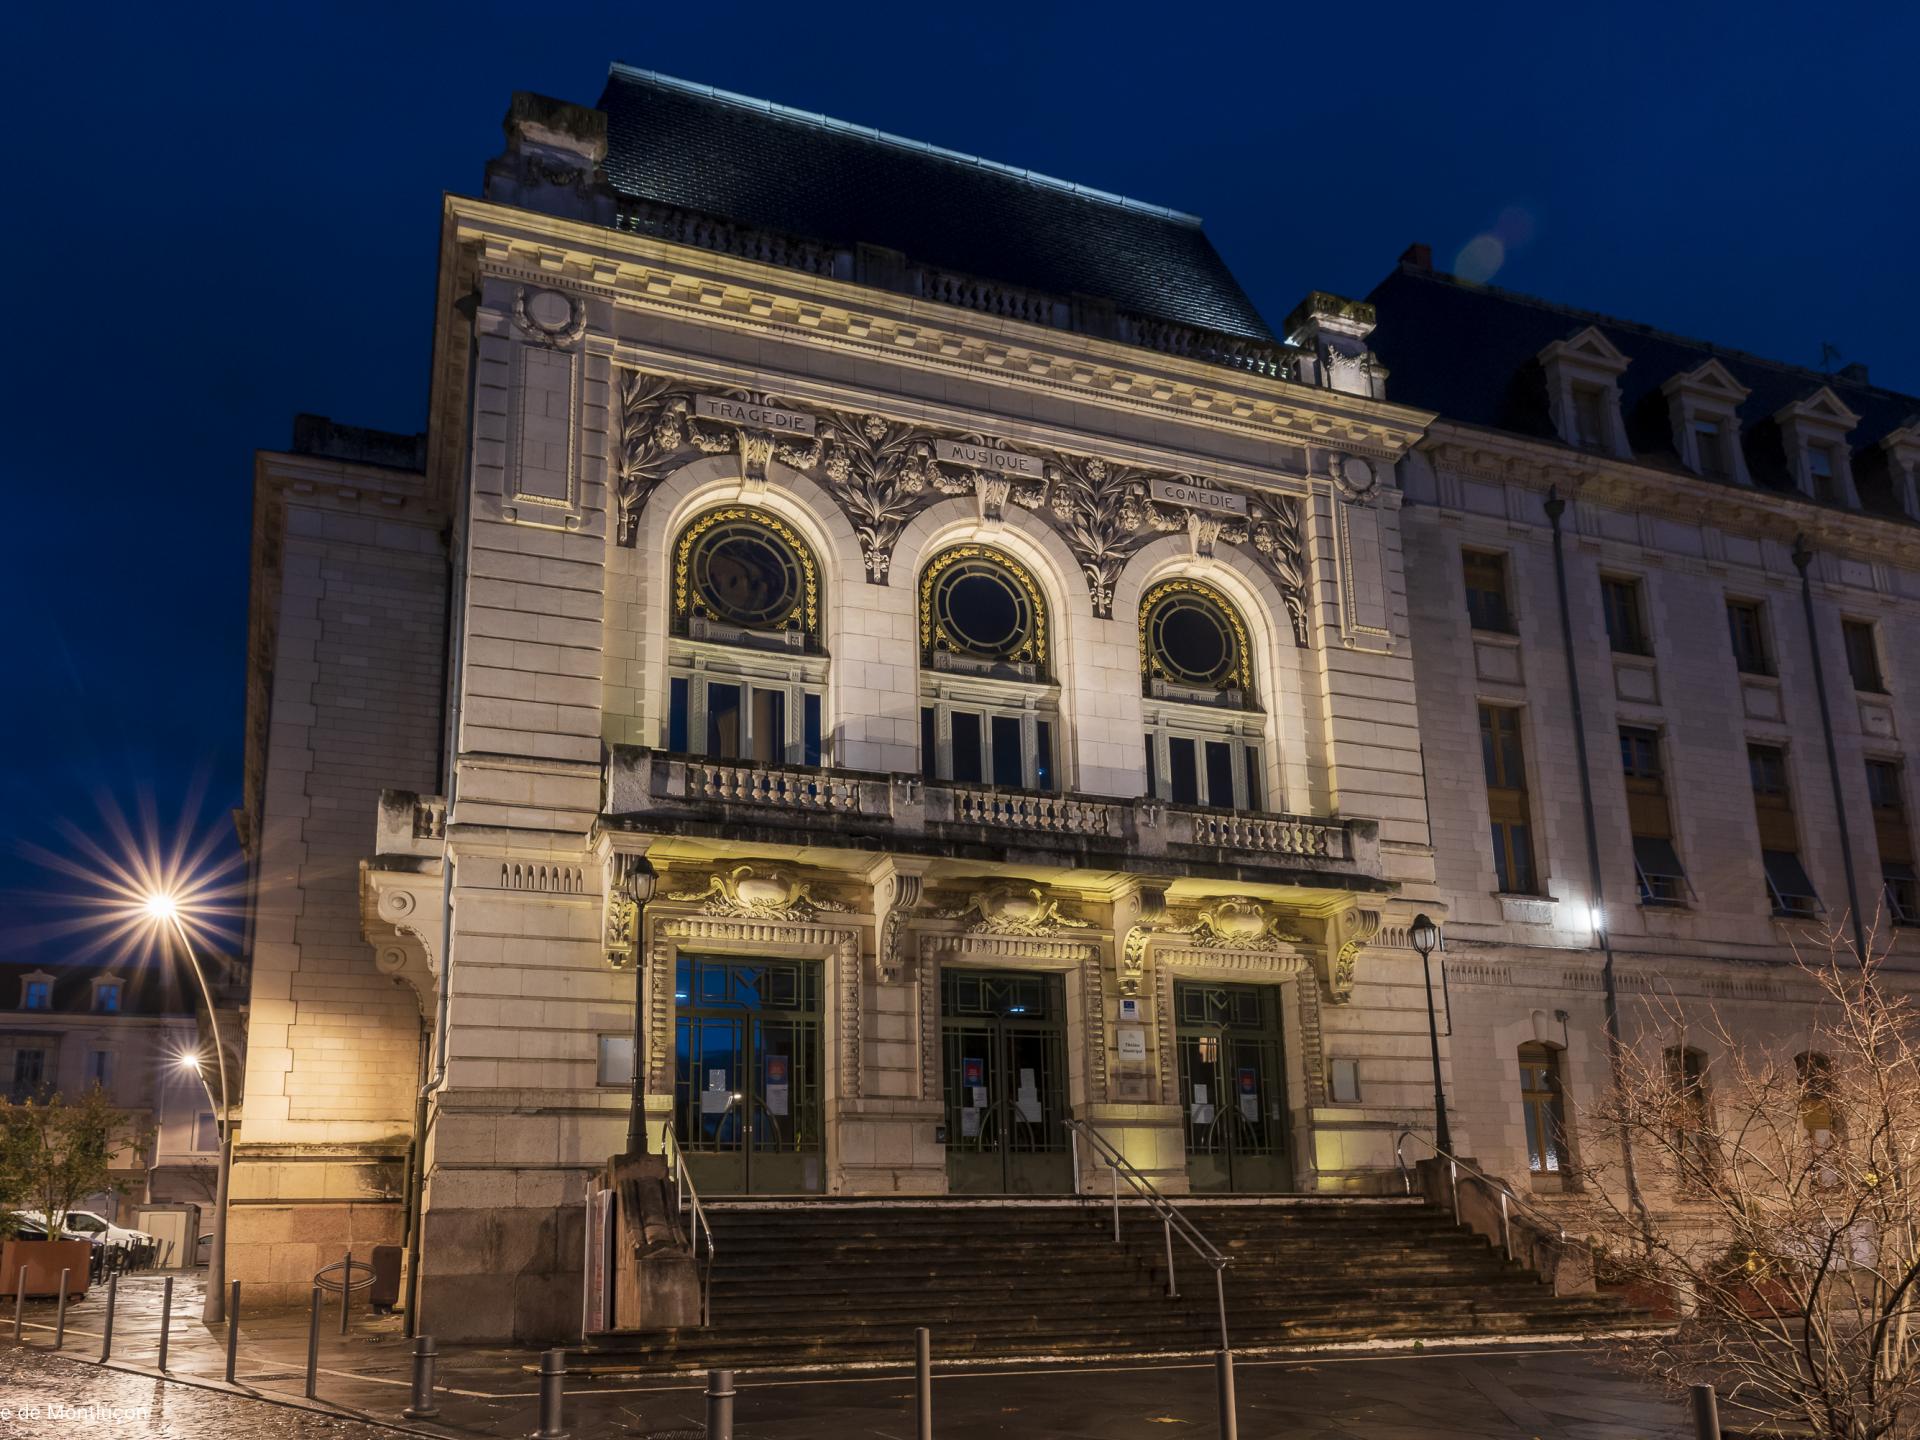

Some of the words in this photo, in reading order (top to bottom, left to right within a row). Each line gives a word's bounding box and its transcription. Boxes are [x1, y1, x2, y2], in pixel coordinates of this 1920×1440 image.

[707, 401, 806, 431] TRAGEDIE
[952, 446, 1030, 472] MUSIQUE
[1164, 487, 1236, 510] COMEDIE
